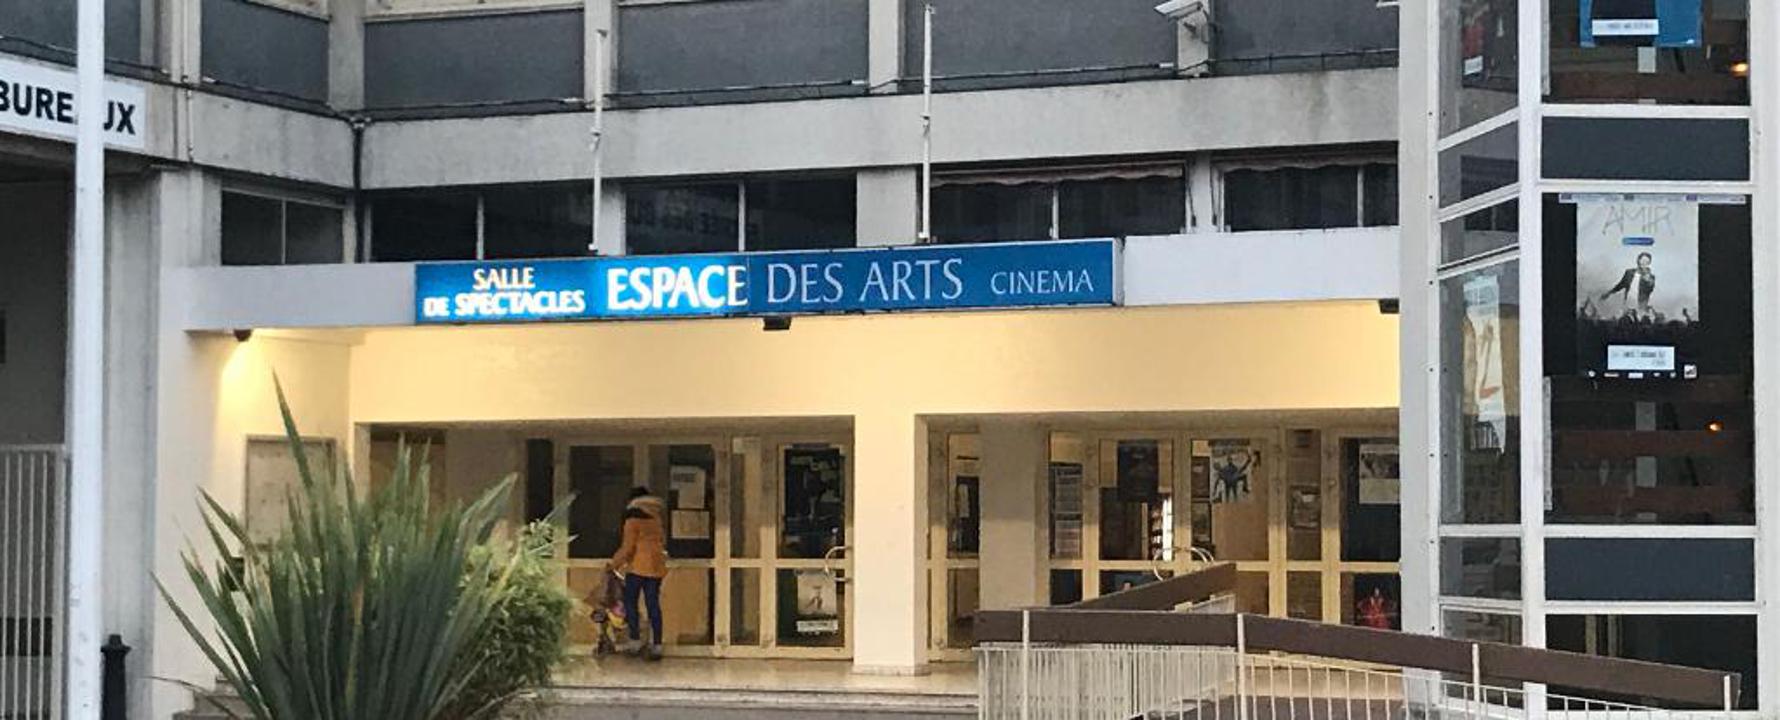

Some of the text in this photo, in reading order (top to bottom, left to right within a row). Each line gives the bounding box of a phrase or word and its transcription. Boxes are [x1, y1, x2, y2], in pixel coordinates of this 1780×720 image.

[0, 79, 136, 135] BUREUX
[1602, 204, 1674, 236] AMIR
[472, 267, 536, 289] SALLE
[606, 257, 1094, 310] ESPACE DES ARTS CINEMA
[424, 289, 586, 317] DE SPECTACLES
